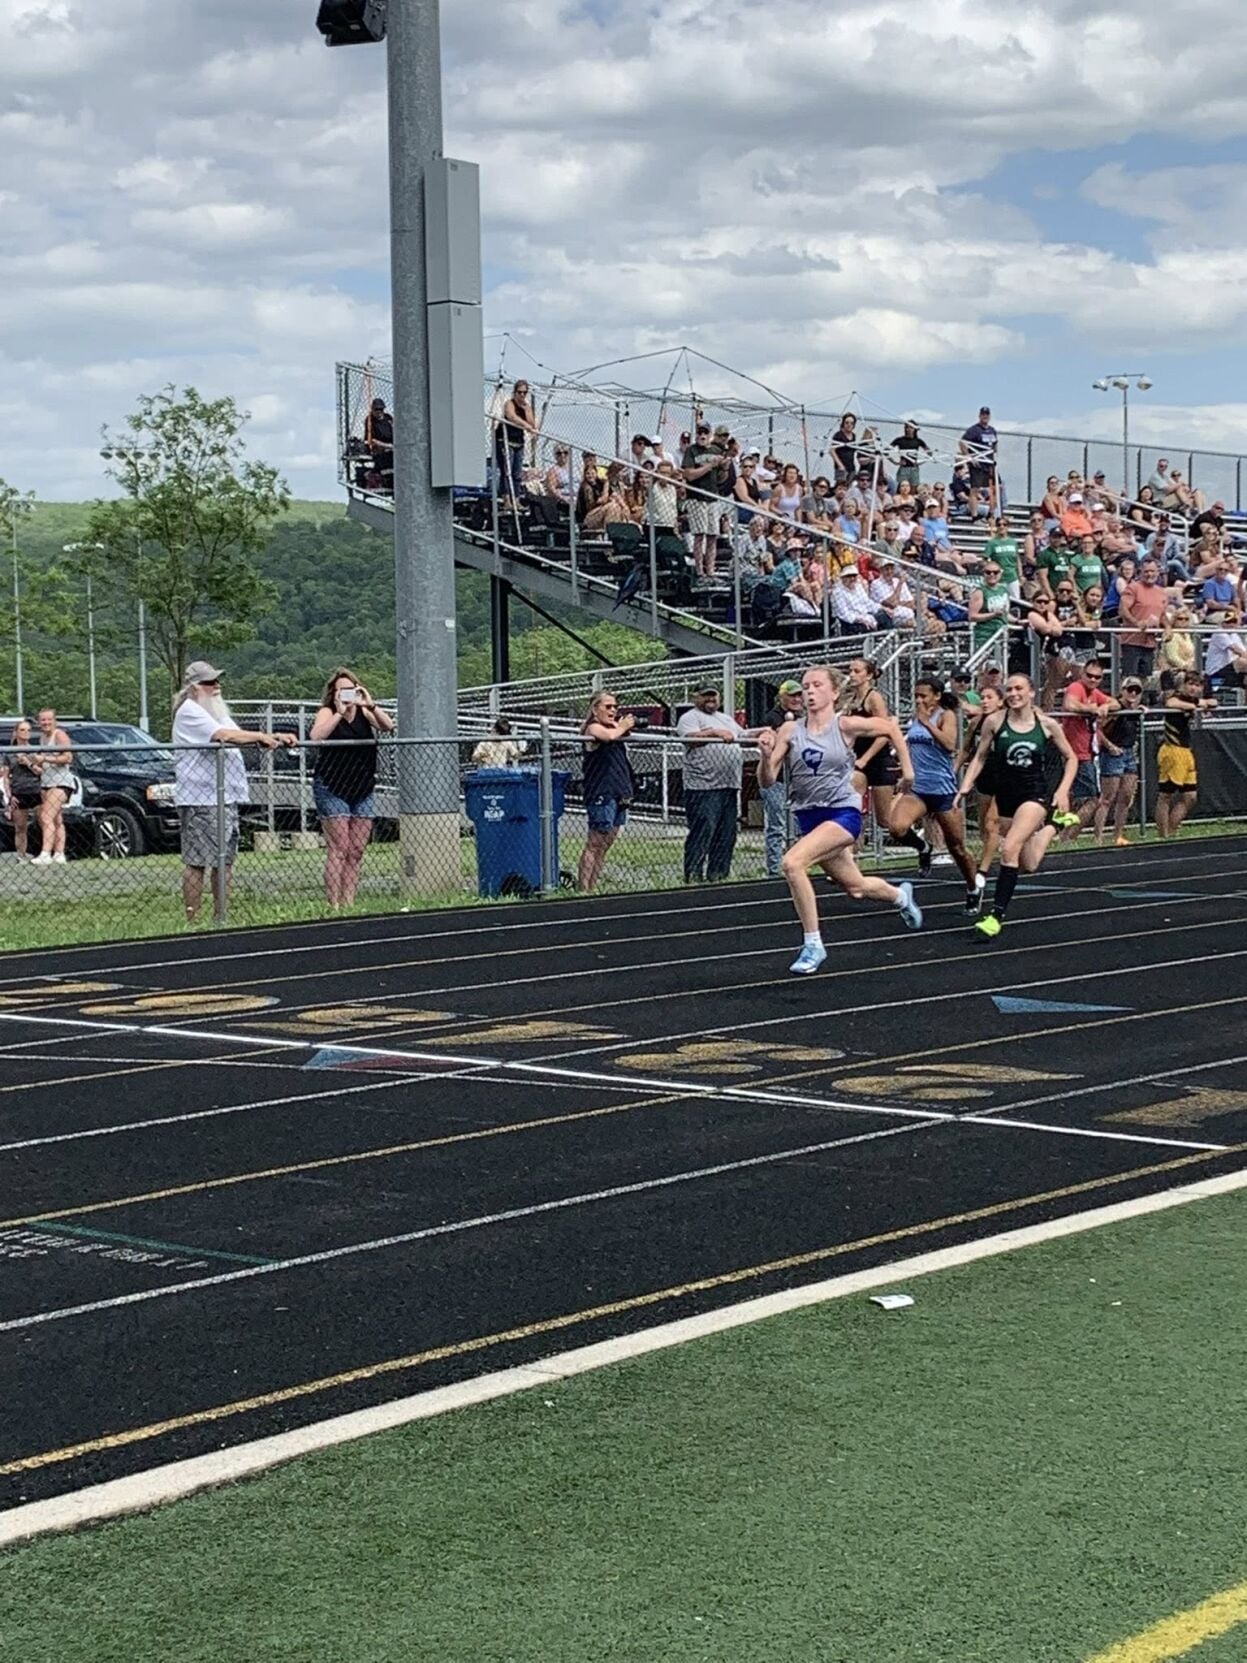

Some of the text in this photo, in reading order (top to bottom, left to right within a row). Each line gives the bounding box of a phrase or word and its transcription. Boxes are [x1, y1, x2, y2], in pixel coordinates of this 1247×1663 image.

[78, 994, 281, 1017] 6
[227, 1007, 457, 1034] 5
[613, 1041, 845, 1074] 3
[831, 1063, 1085, 1100] 2
